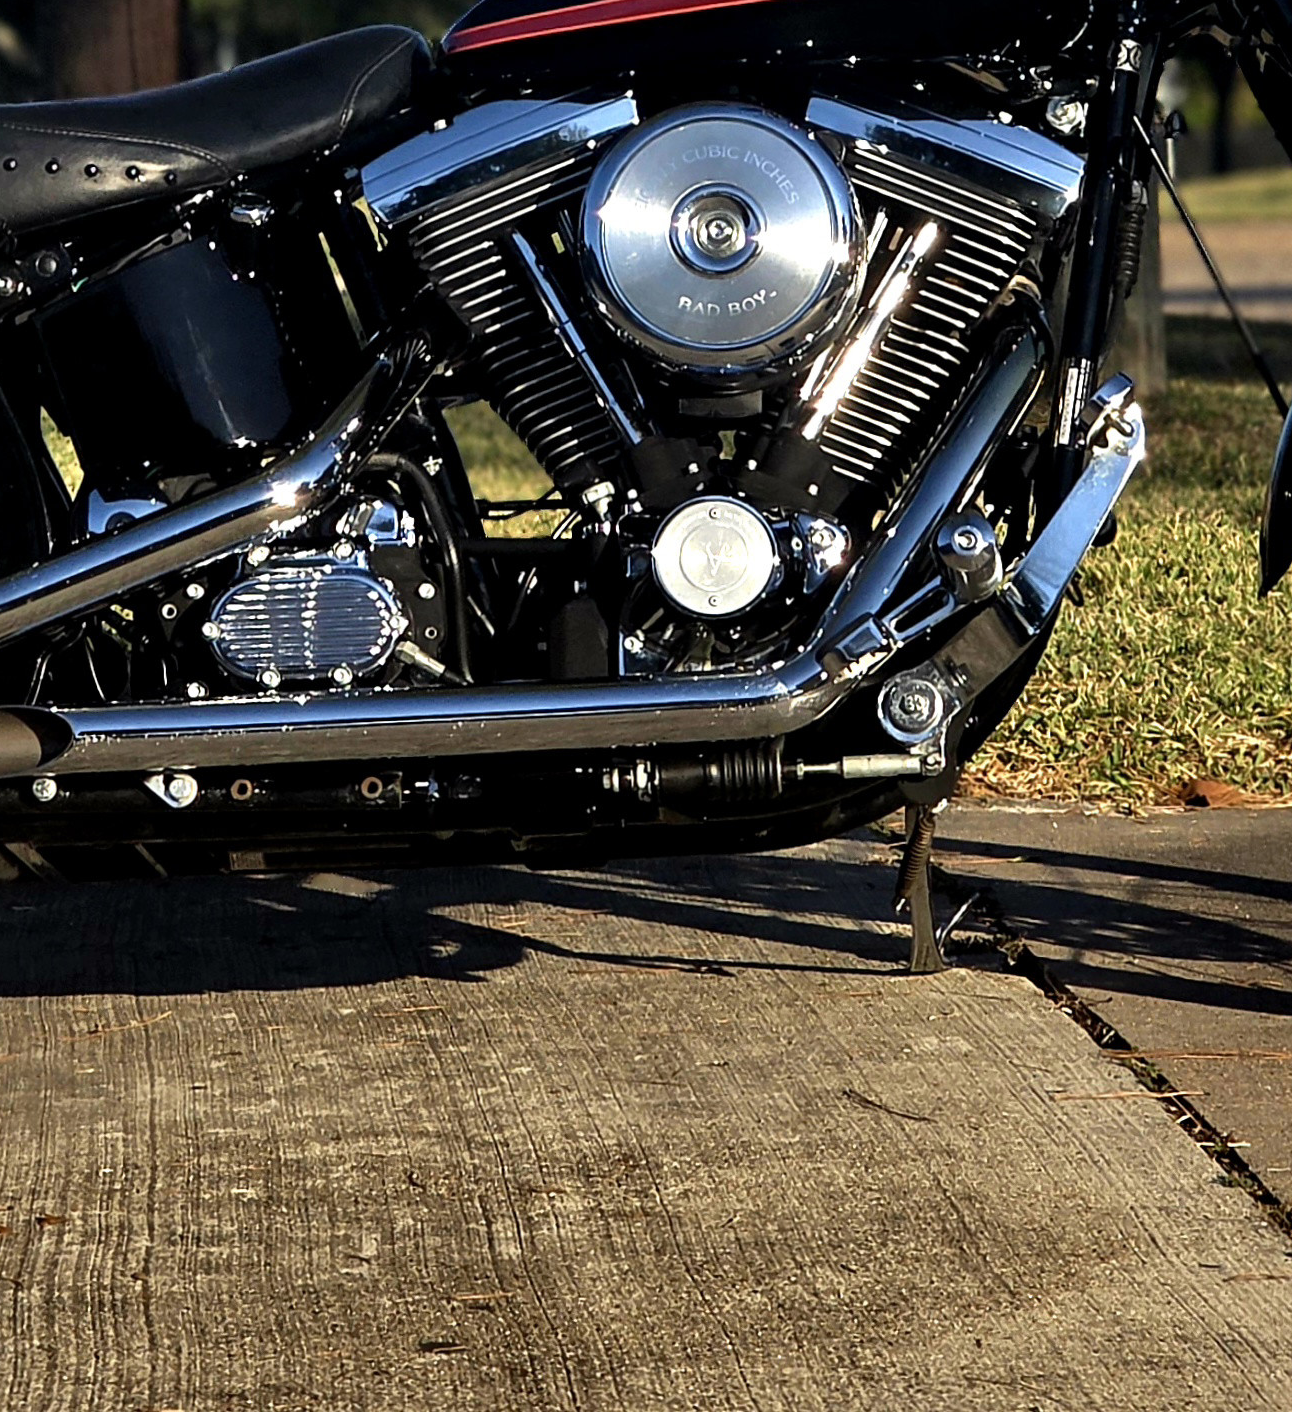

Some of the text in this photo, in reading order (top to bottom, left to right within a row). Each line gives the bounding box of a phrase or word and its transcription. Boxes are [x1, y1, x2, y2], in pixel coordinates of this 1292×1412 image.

[682, 144, 800, 206] CUBIC INCHES
[678, 295, 721, 317] BAD
